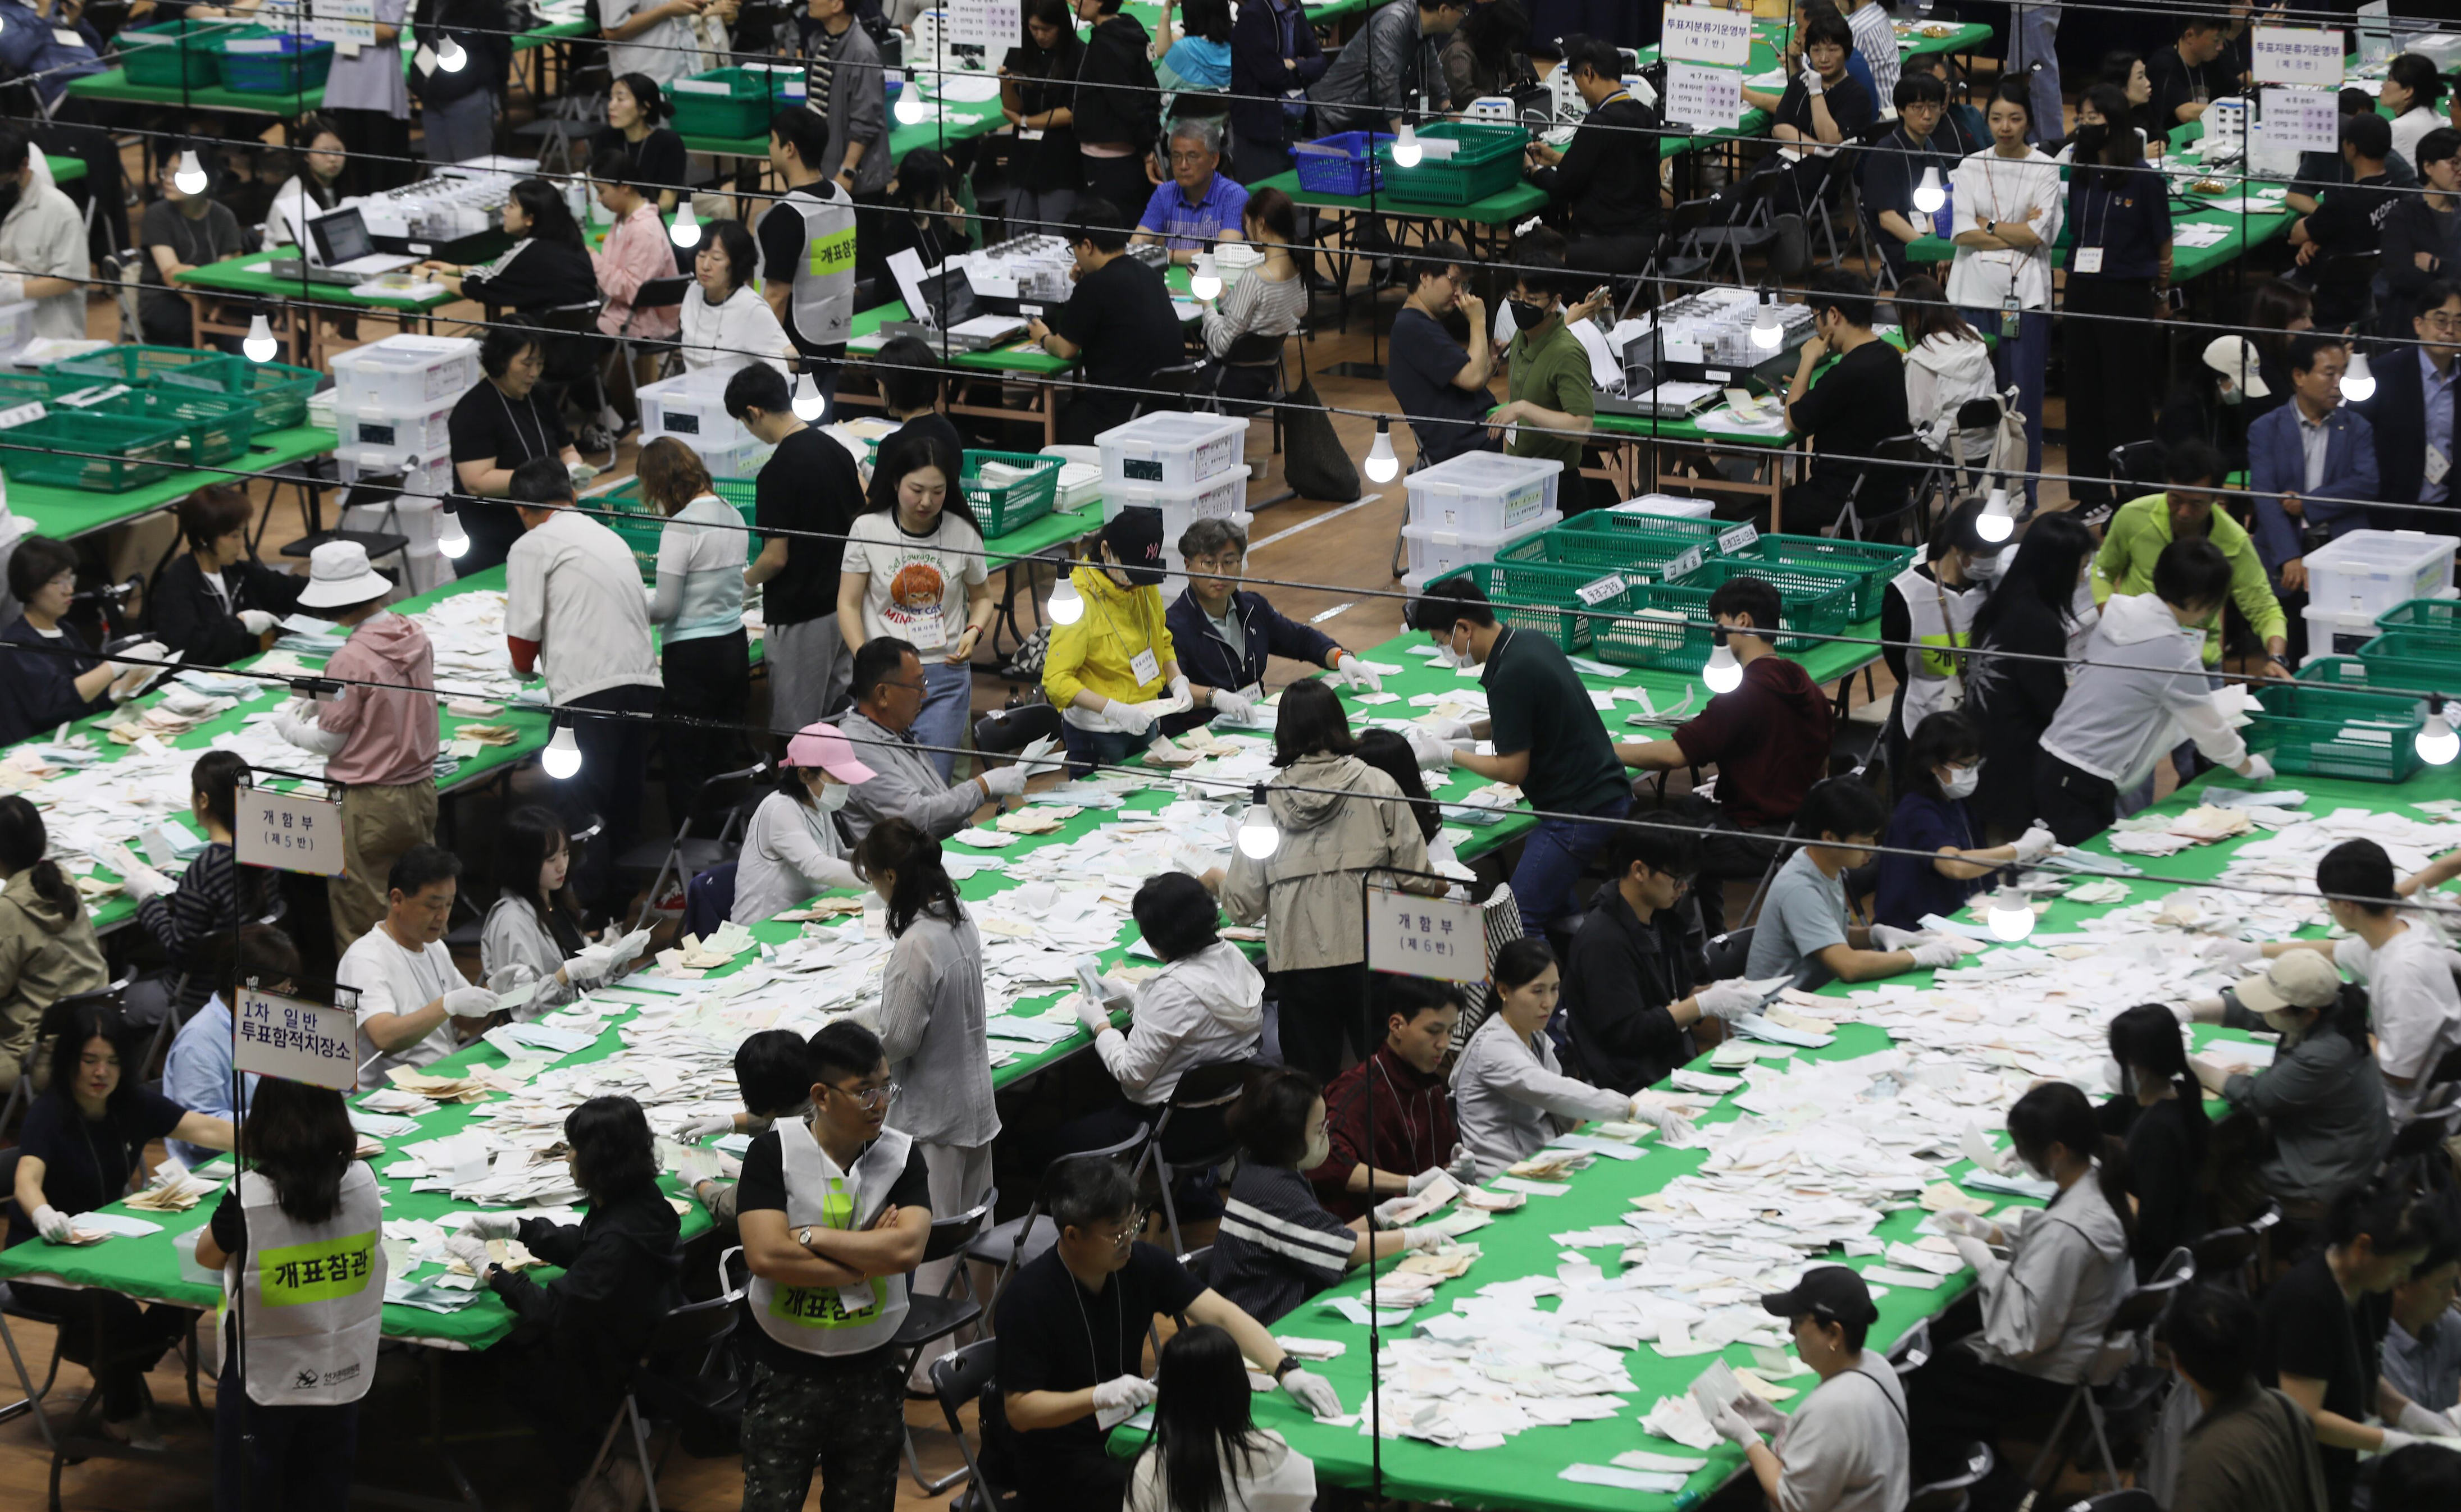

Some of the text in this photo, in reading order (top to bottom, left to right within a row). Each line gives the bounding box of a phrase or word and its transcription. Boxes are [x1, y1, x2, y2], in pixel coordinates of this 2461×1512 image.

[1667, 18, 1747, 38] 투표지분류기운영부
[903, 553, 936, 562] courage
[1146, 542, 1159, 560] NY
[244, 1002, 270, 1023] 1차
[240, 1021, 351, 1061] 투표함적치장소
[275, 1248, 367, 1289] 개표참관
